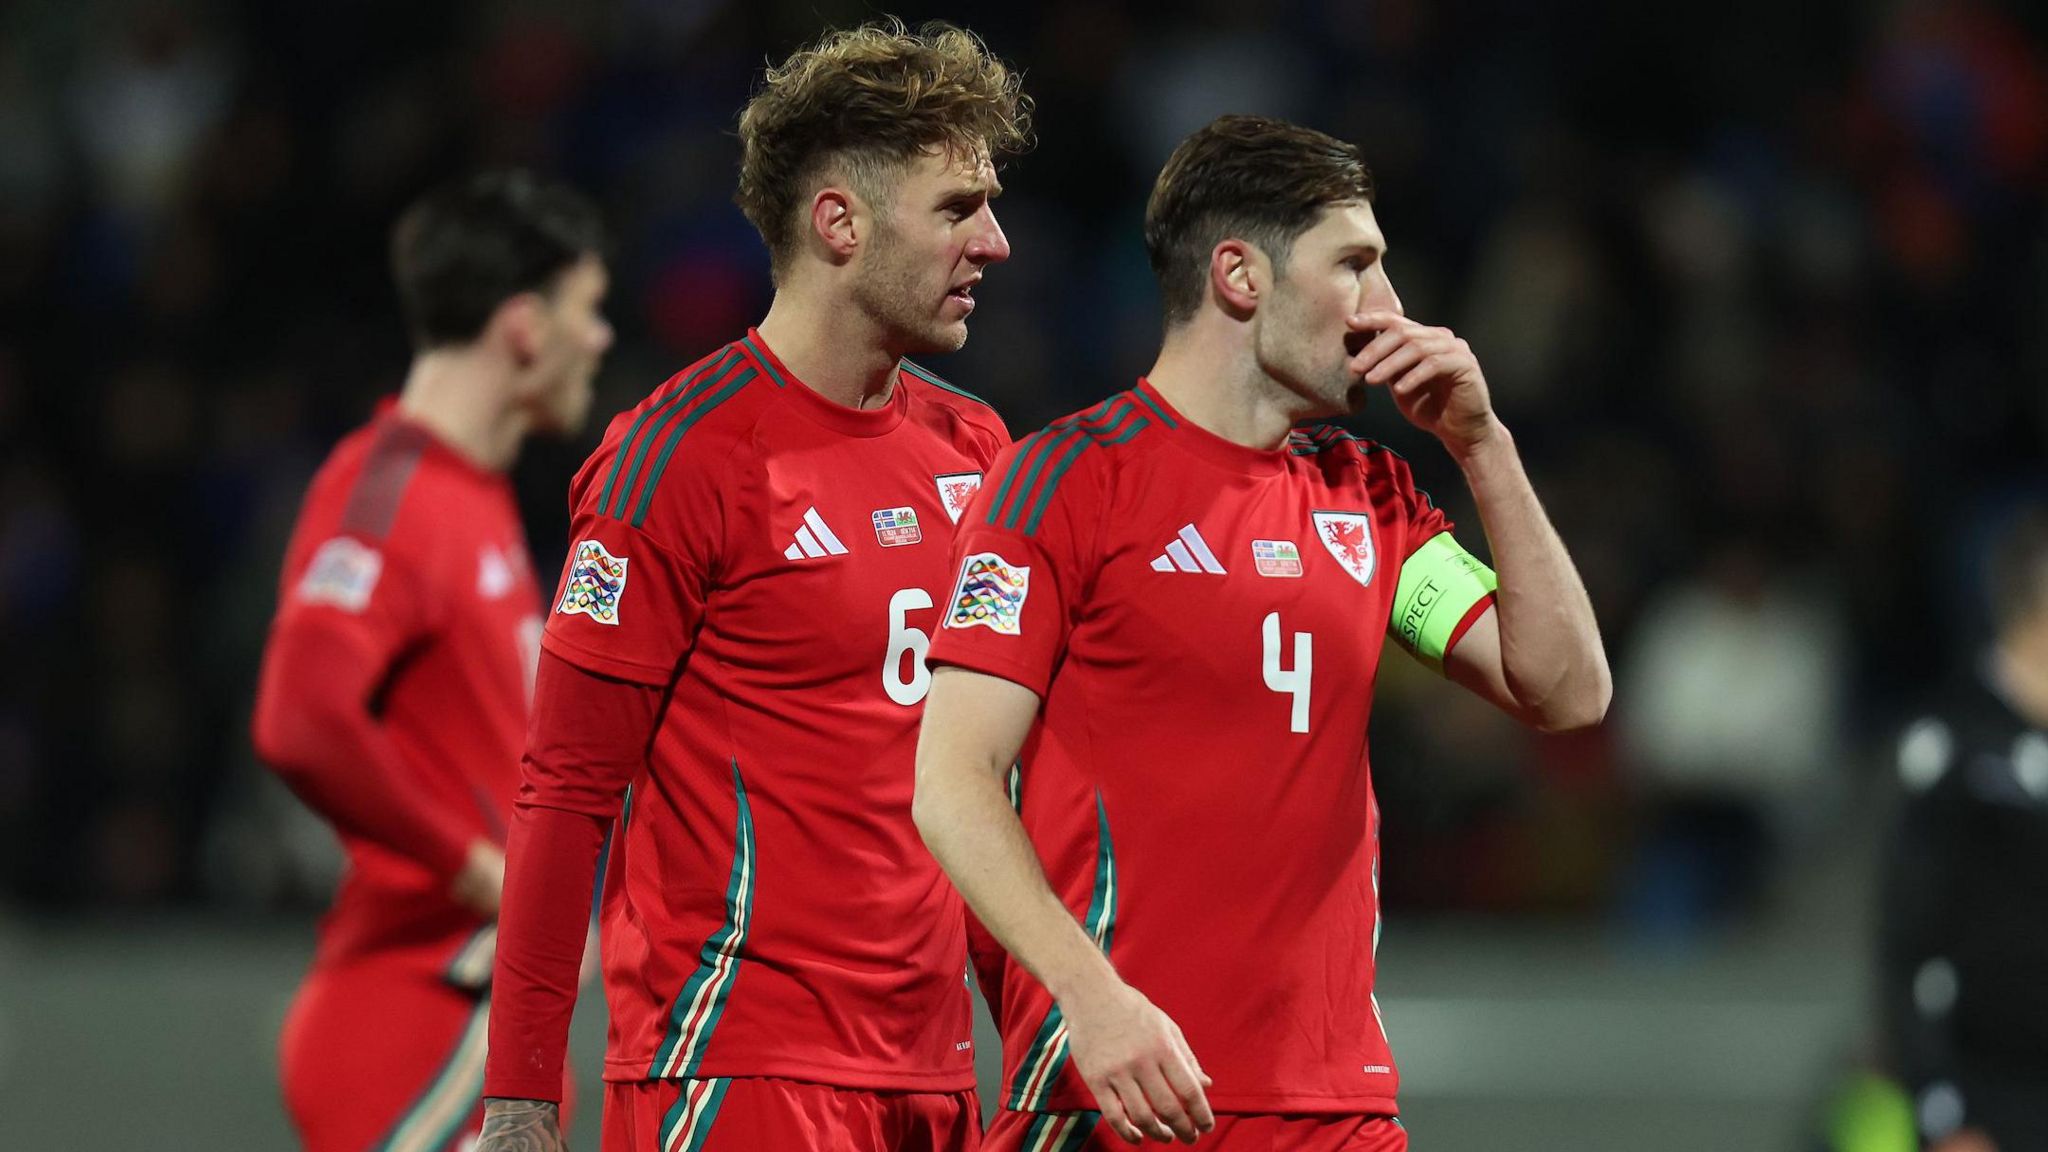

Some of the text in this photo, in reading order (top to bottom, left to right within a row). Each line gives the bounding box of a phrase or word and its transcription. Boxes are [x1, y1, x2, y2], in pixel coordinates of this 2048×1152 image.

[882, 588, 934, 706] 6
[1404, 579, 1439, 643] SPECT
[1262, 611, 1312, 733] 4
